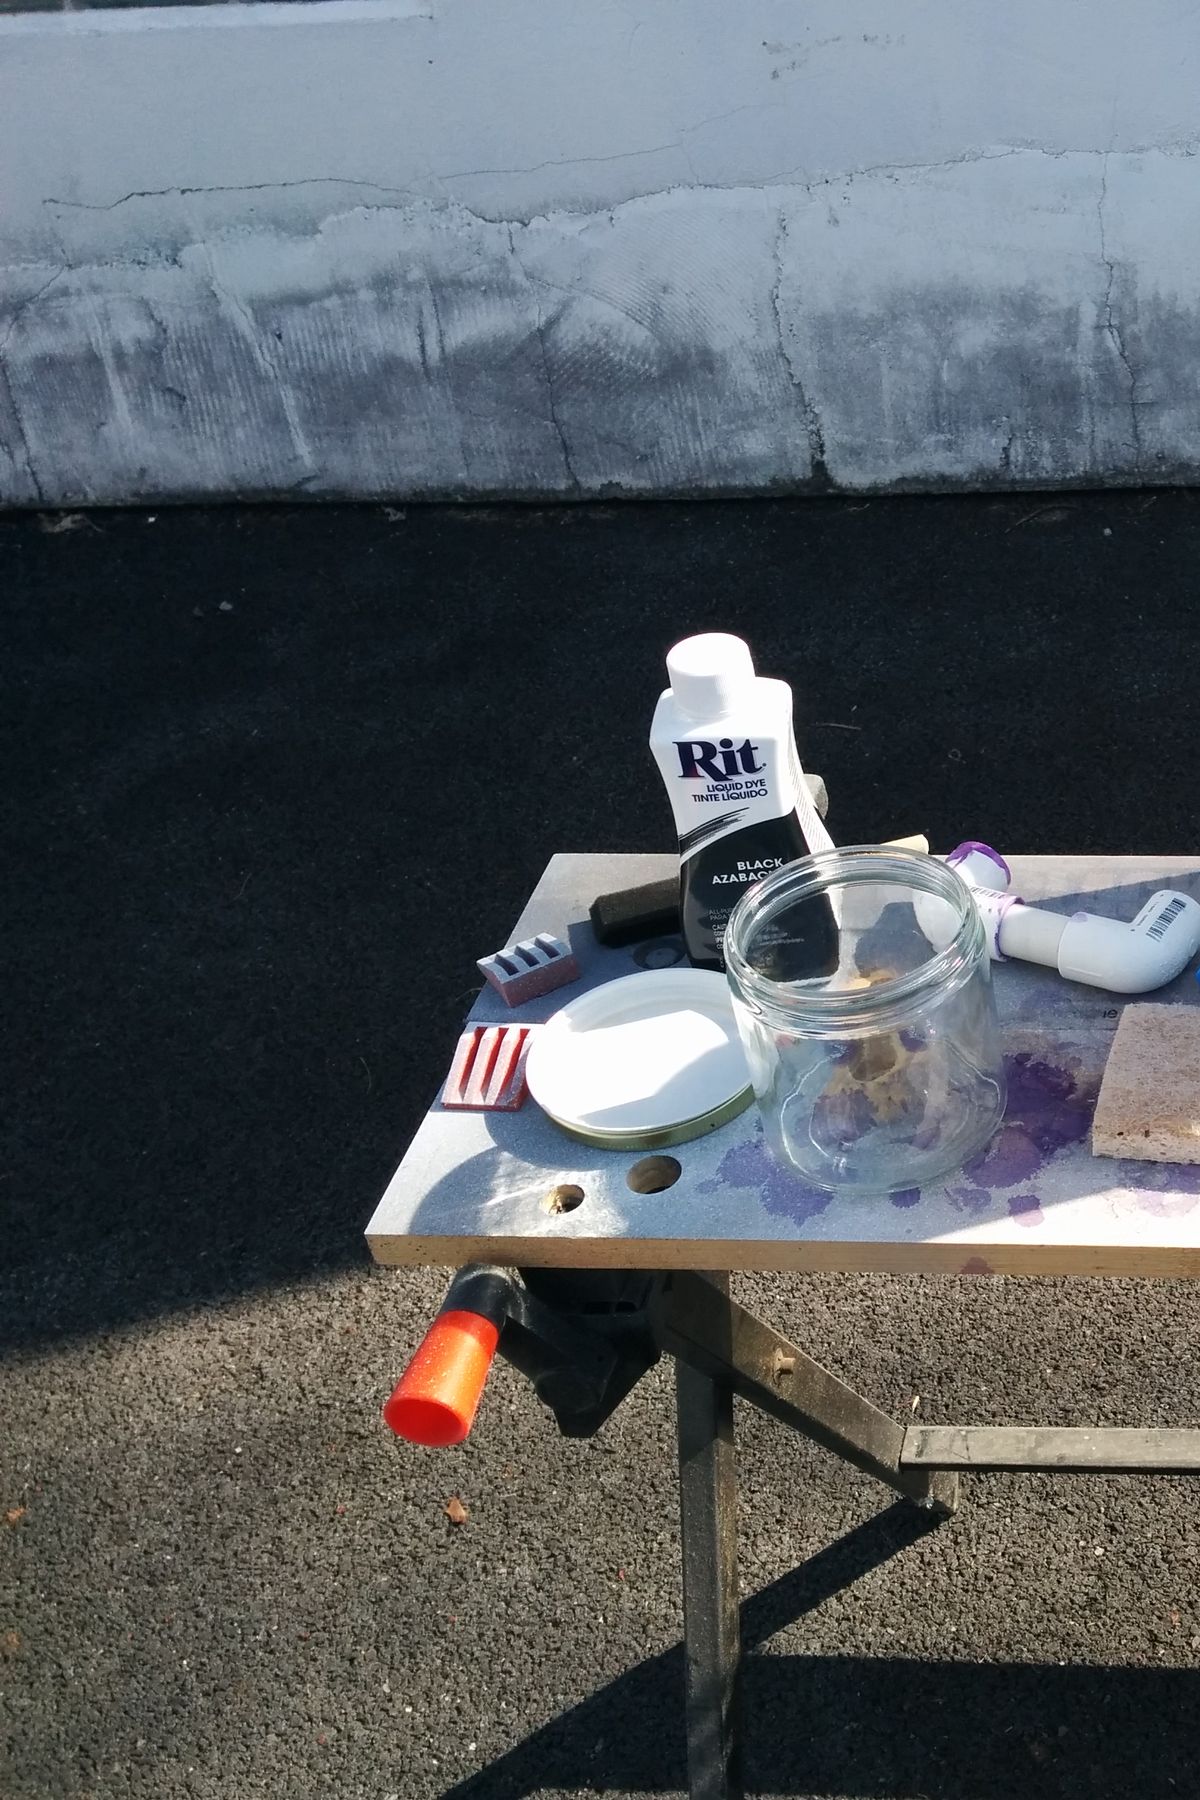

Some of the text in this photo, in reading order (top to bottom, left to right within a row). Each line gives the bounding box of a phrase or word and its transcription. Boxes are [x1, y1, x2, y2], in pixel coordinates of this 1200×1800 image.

[672, 738, 763, 781] Rit
[706, 779, 767, 793] LIQUID DYE
[692, 794, 720, 802] TINTE
[736, 858, 784, 871] BLACK
[712, 870, 776, 885] AZABAC
